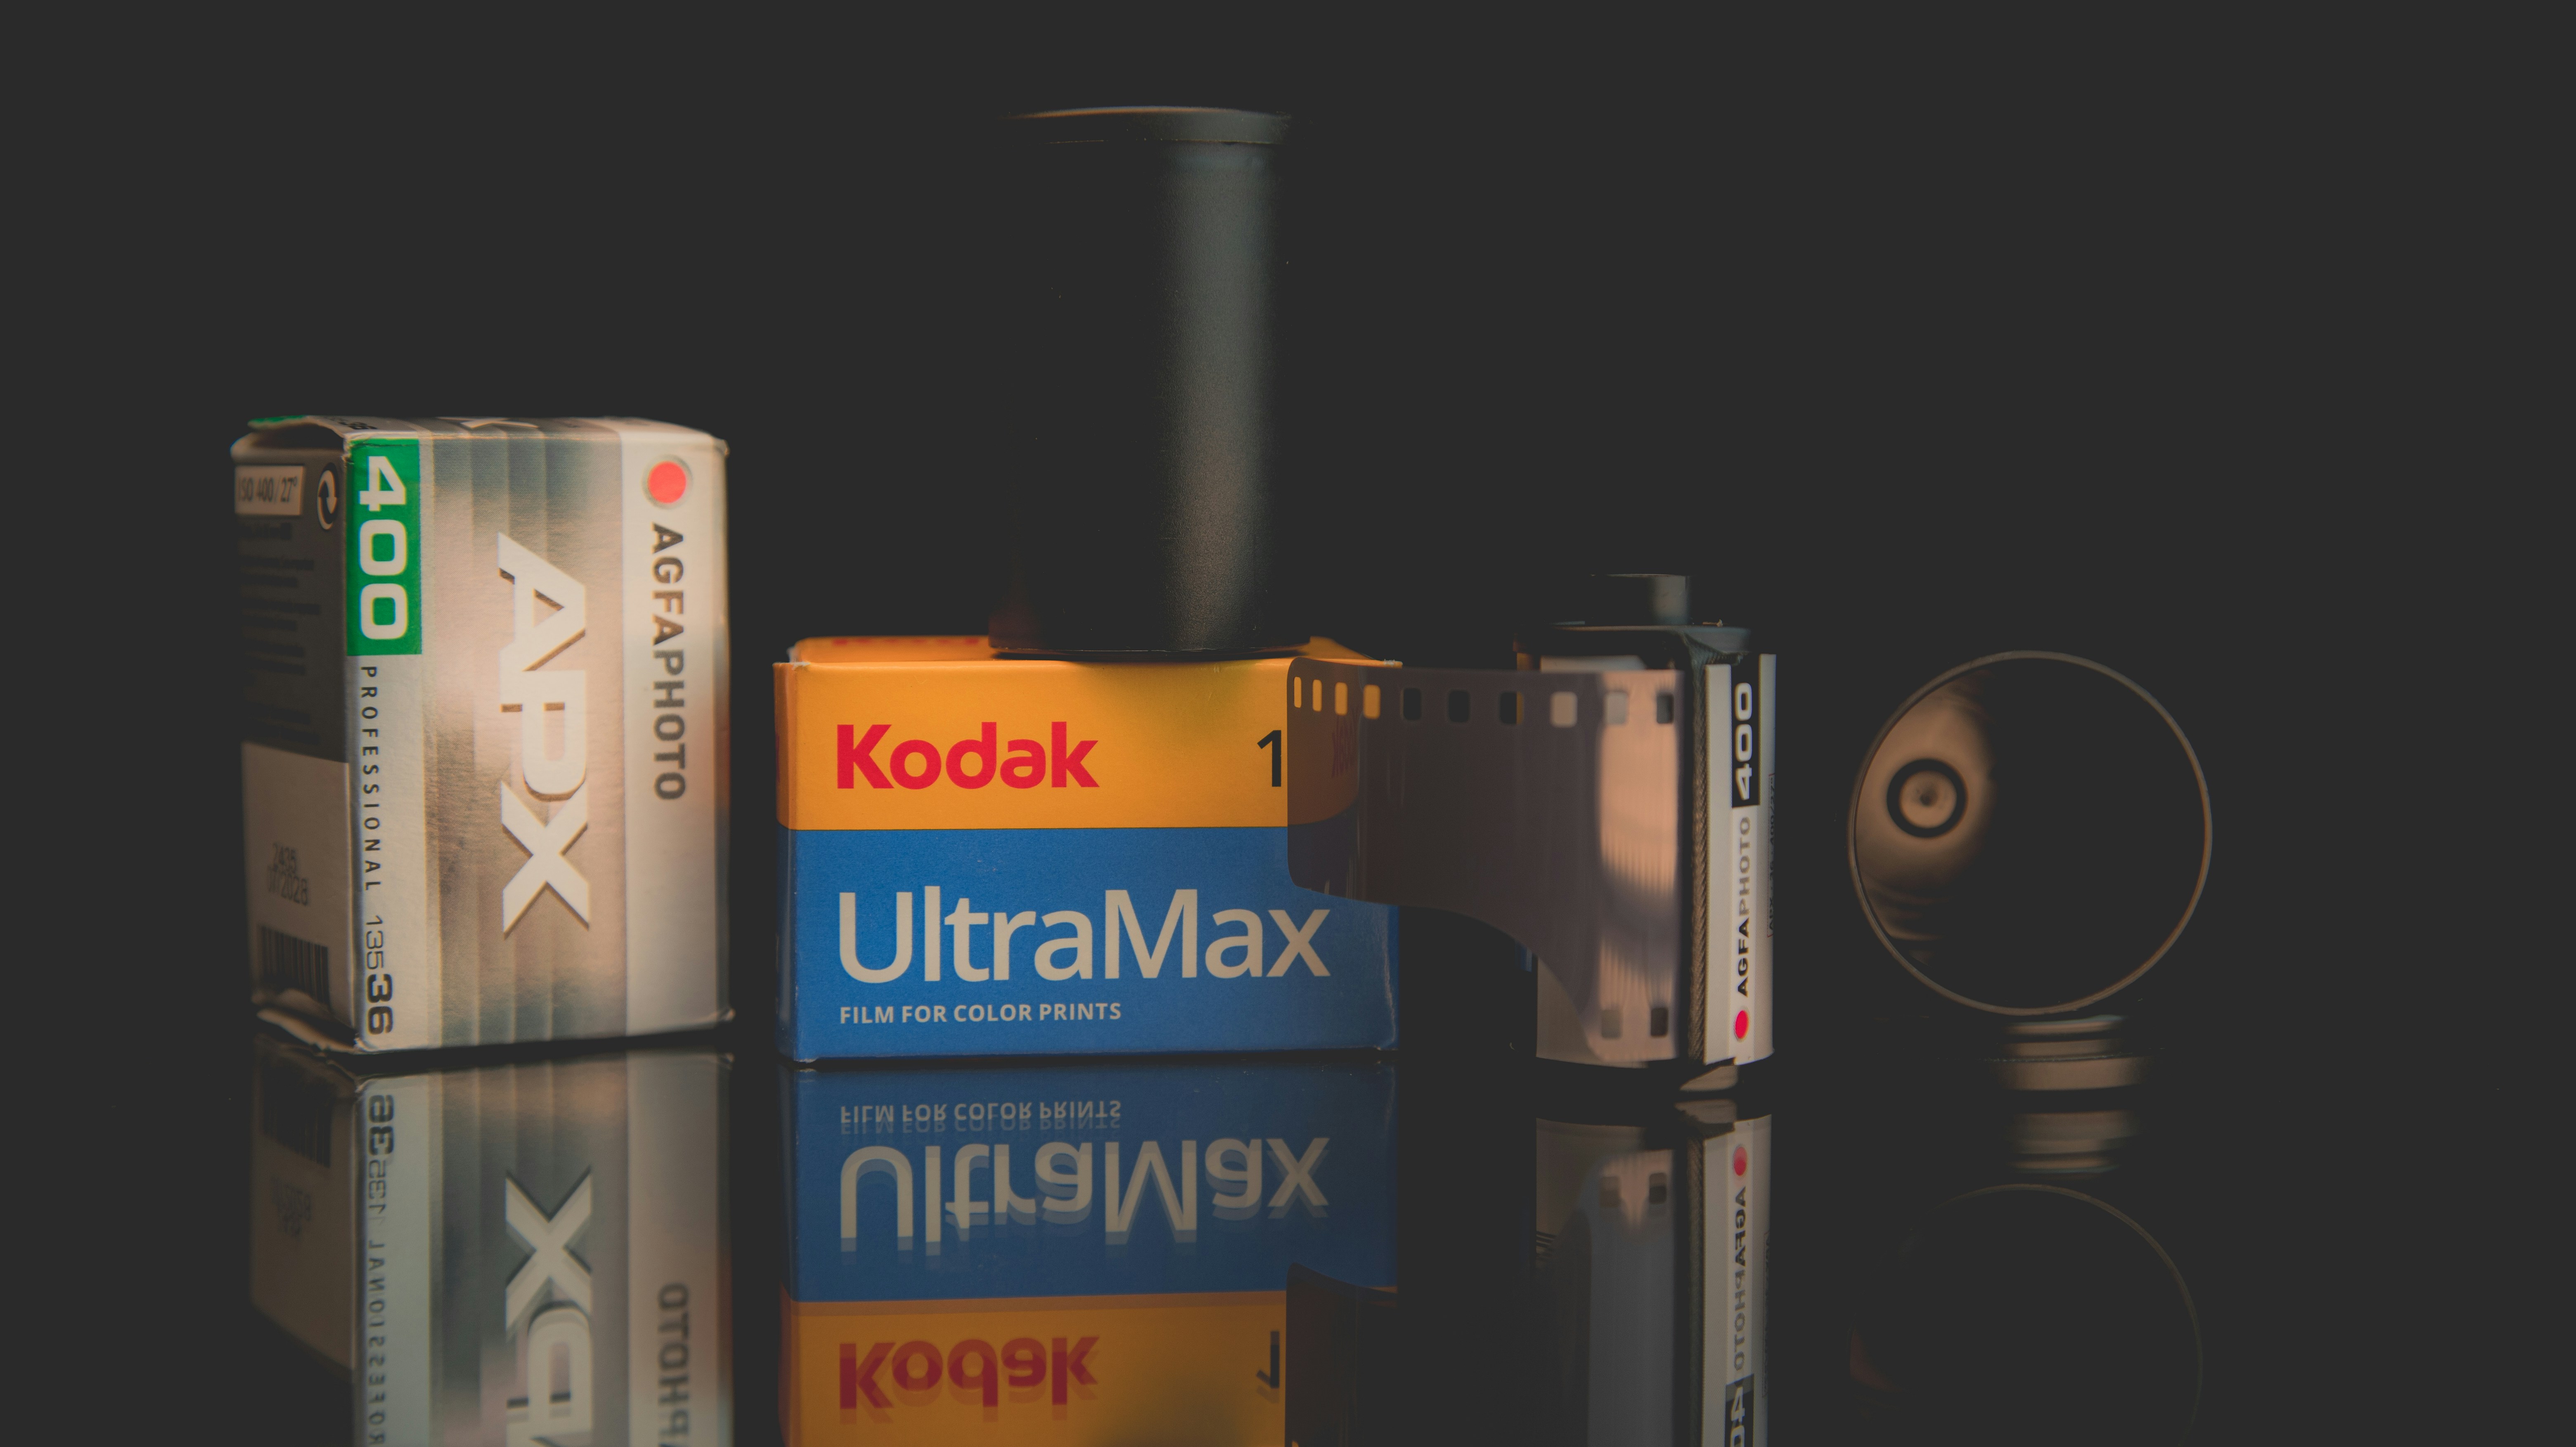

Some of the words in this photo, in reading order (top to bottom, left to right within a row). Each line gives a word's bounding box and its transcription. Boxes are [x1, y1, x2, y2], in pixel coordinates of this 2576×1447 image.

[359, 455, 409, 640] 400
[498, 531, 590, 939] APX
[651, 522, 686, 800] AGFAPHOTO
[1735, 682, 1753, 801] 400
[360, 666, 381, 890] PROFESSIONAL
[837, 721, 1100, 790] Kodak
[839, 885, 1331, 984] UltraMax
[1737, 816, 1751, 998] AGFAPHOTO
[840, 1006, 894, 1024] FILM
[902, 1005, 947, 1023] FOR
[954, 1004, 1032, 1022] COLOR
[1039, 1003, 1122, 1021] PRINTS
